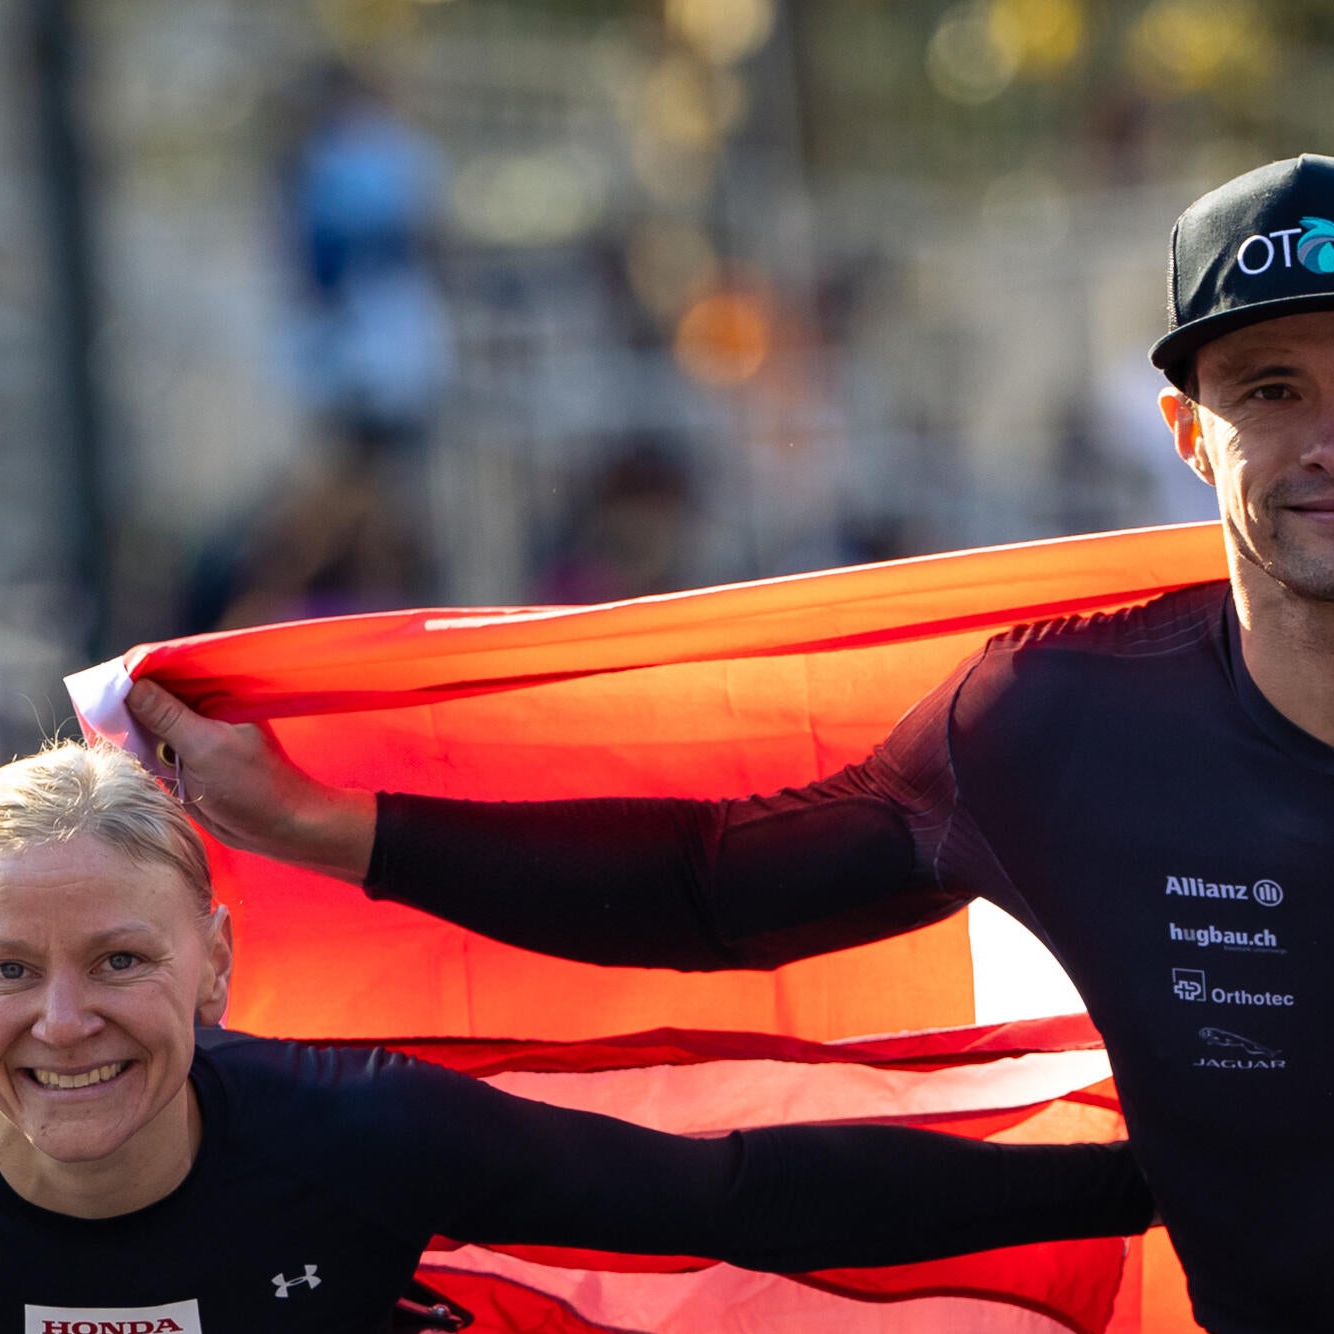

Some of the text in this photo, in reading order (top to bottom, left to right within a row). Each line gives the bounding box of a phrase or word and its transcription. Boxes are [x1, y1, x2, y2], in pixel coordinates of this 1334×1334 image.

[1165, 875, 1248, 900] Allianz
[1169, 922, 1277, 947] hugbau.ch
[1211, 988, 1294, 1006] Orthotec
[1192, 1058, 1286, 1069] JAGUAR
